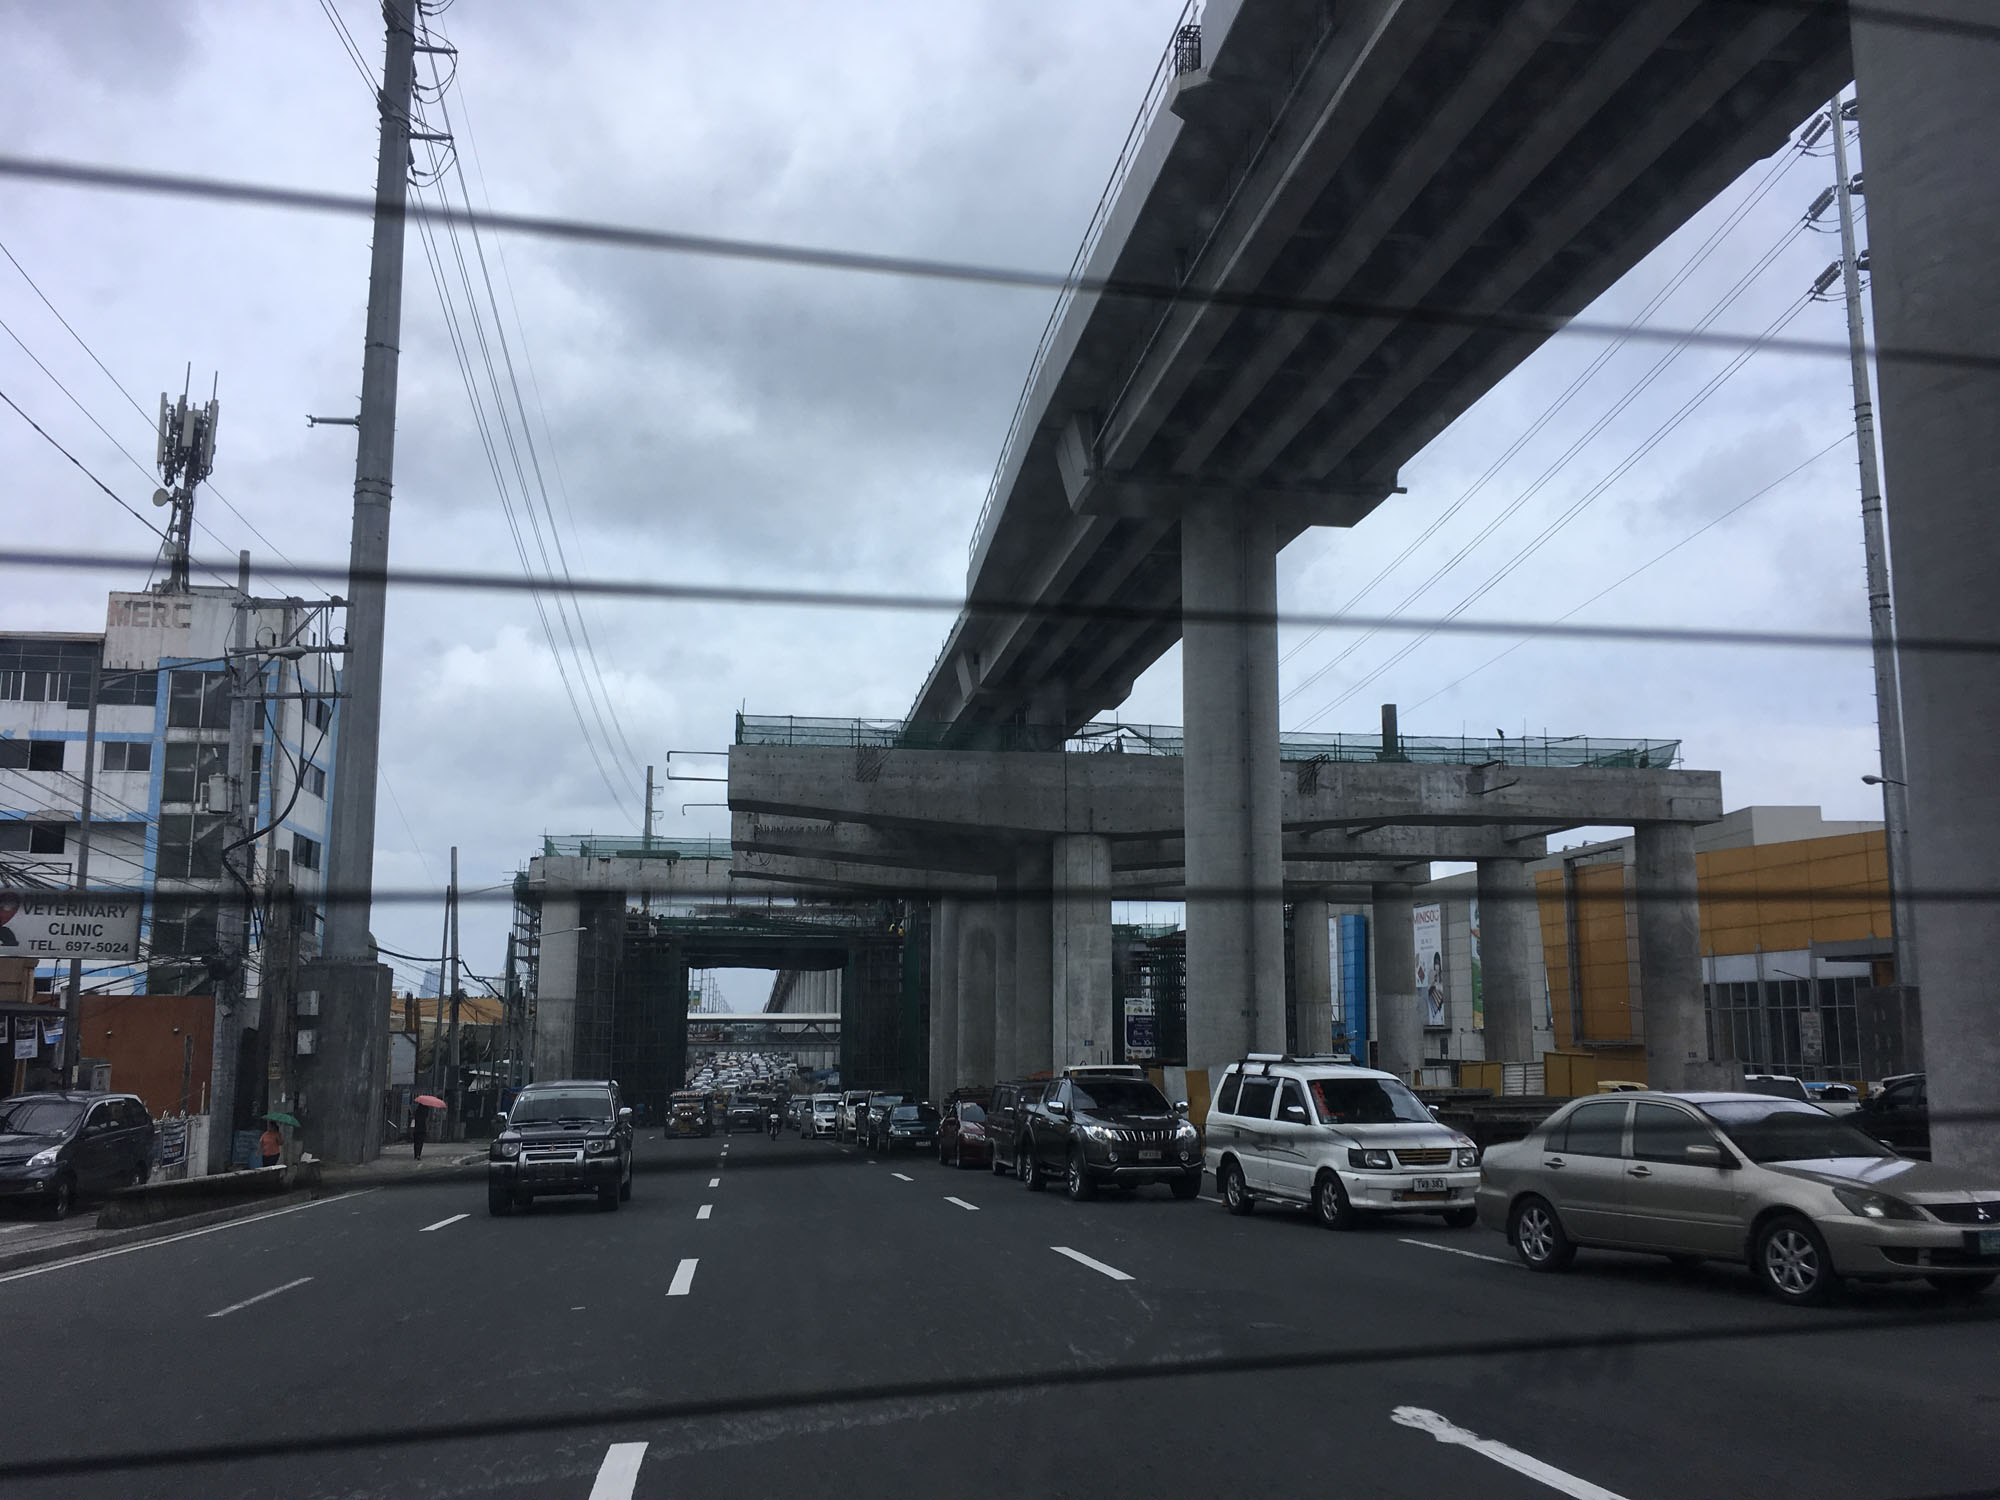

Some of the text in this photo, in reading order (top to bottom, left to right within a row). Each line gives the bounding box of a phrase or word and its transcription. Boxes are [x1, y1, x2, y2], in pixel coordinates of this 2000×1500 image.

[23, 902, 129, 918] VETERINARY
[48, 922, 104, 937] CLINIC
[28, 940, 129, 953] TEL. 697-5024
